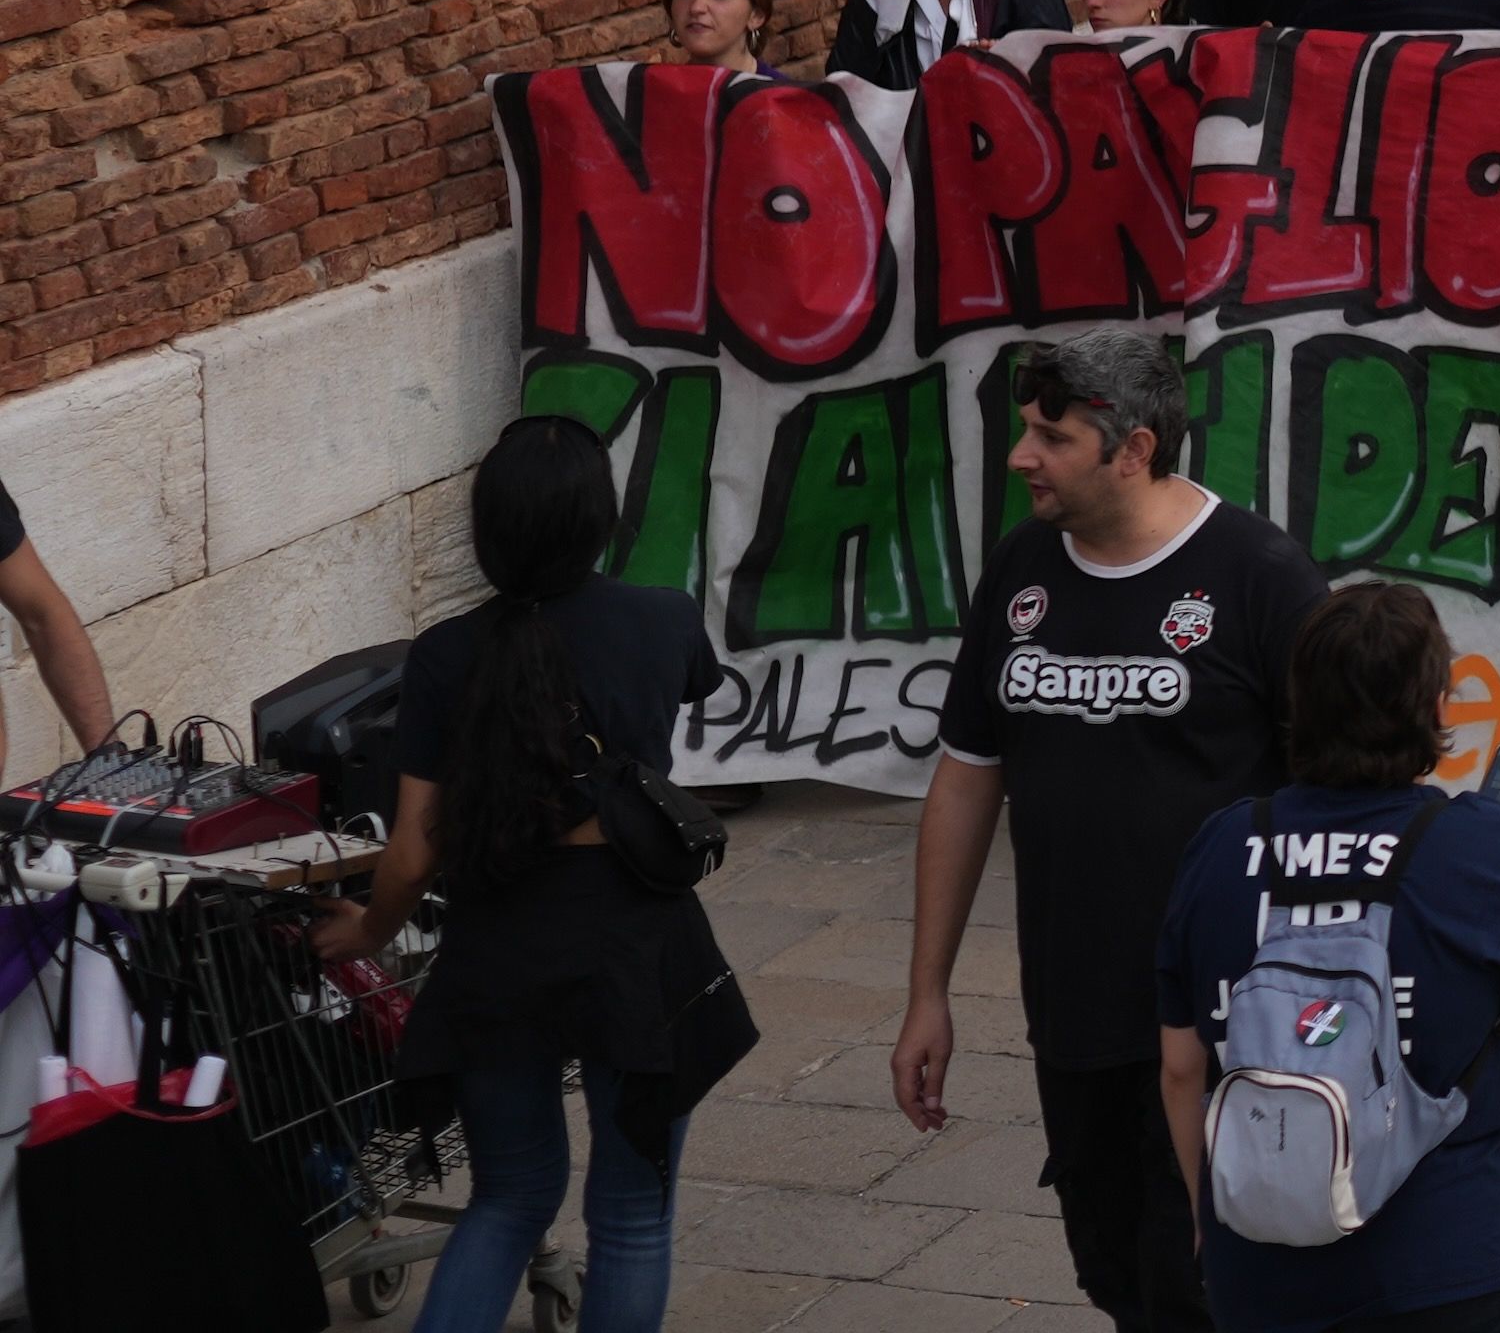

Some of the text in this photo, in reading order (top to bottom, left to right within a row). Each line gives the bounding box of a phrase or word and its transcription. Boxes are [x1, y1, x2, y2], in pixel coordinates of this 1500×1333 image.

[492, 64, 895, 383] NO
[688, 657, 946, 763] PALES
[1006, 654, 1180, 709] Sanpre
